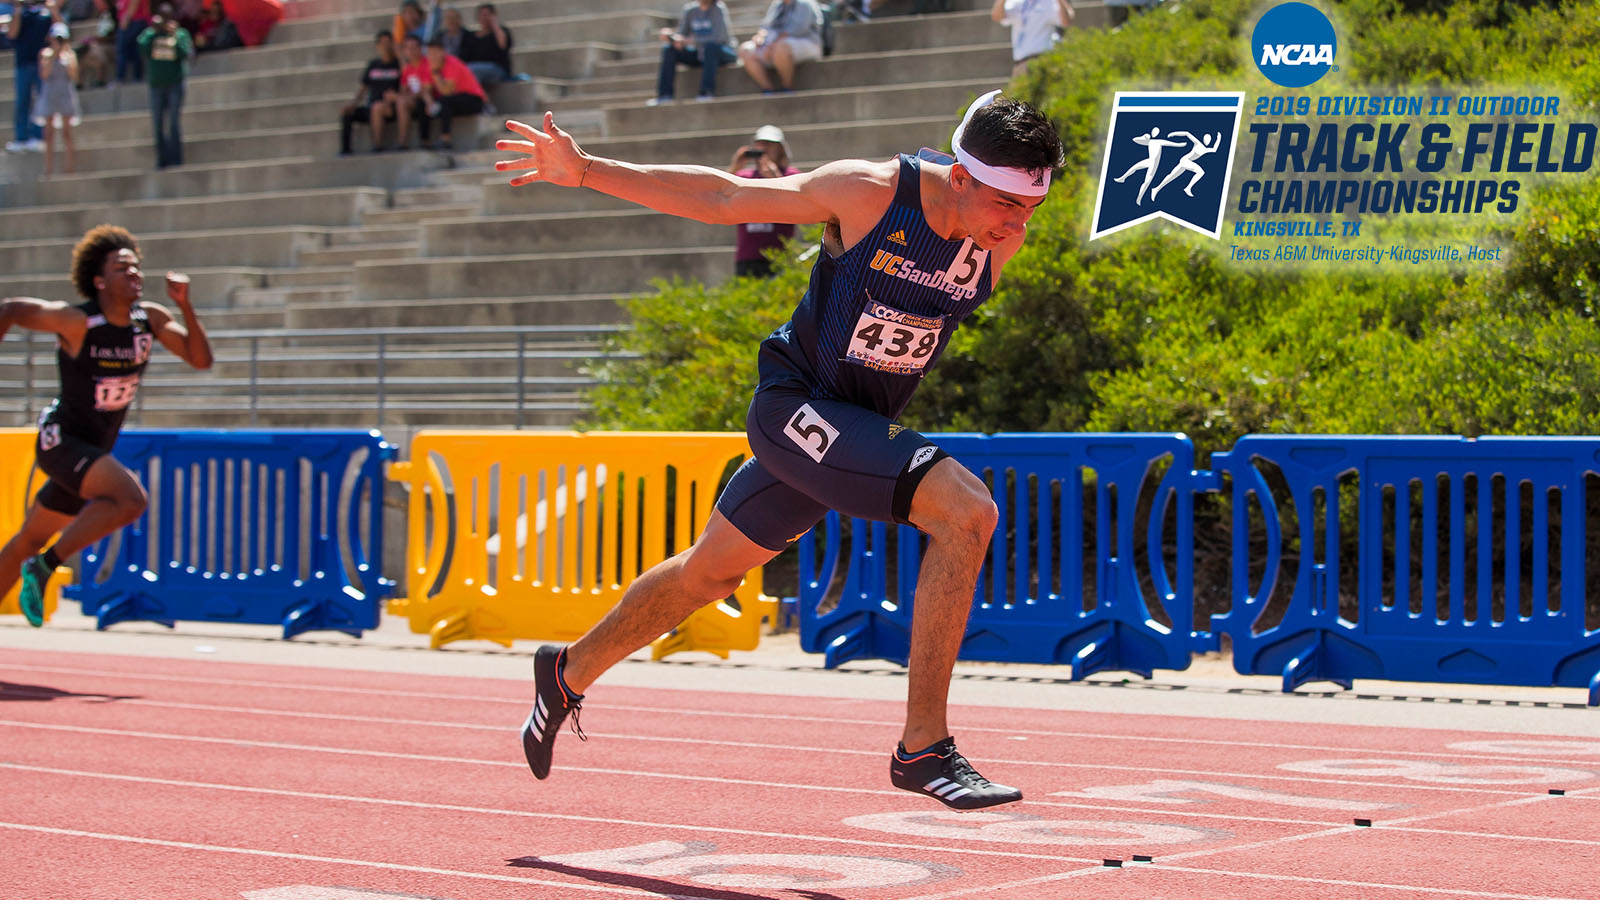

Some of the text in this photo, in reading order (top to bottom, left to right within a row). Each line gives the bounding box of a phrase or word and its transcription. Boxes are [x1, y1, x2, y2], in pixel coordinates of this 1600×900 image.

[953, 242, 983, 285] 5
[856, 322, 935, 358] 438
[864, 360, 879, 370] SAN
[791, 411, 829, 454] 5
[842, 810, 1215, 846] 6
[537, 839, 950, 889] 5
